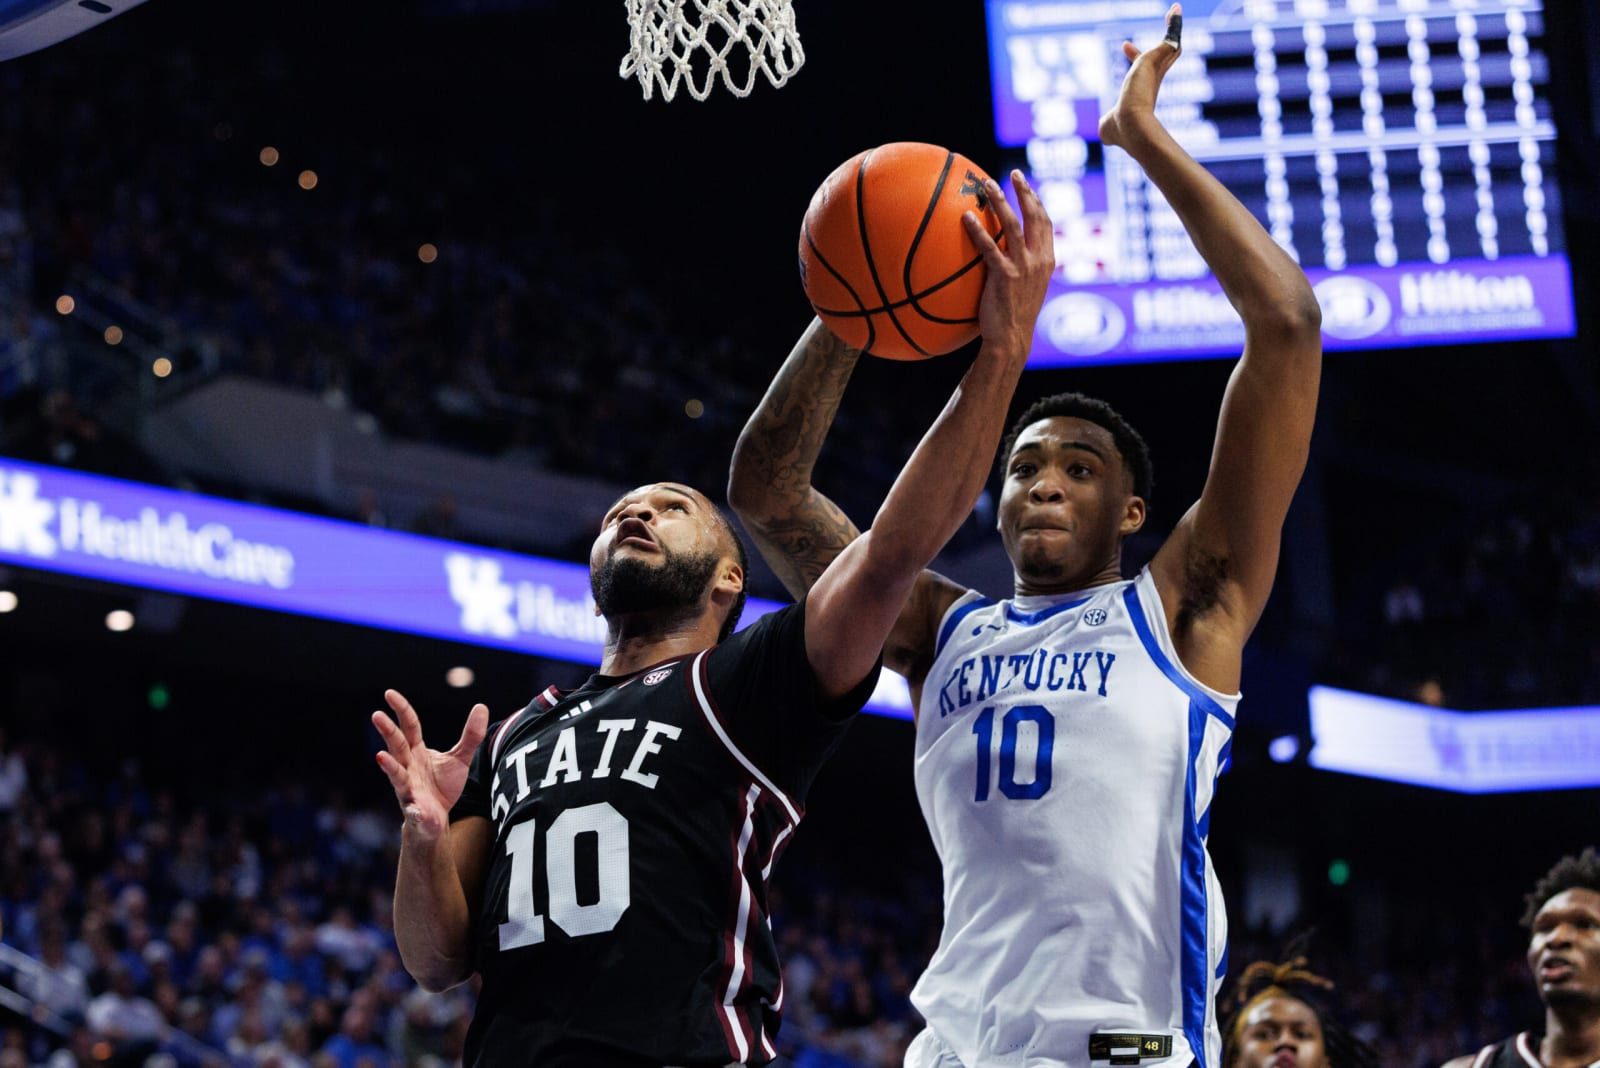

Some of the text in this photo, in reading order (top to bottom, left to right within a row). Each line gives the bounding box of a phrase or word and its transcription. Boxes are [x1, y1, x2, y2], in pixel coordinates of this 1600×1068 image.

[1132, 286, 1243, 334] Hilto
[59, 497, 294, 589] HealthCare
[1085, 609, 1106, 625] SEC
[939, 648, 1116, 718] KENTUCKY
[491, 718, 682, 841] STATE
[972, 704, 1056, 802] 10
[498, 801, 631, 951] 10
[1144, 1040, 1159, 1051] 48
